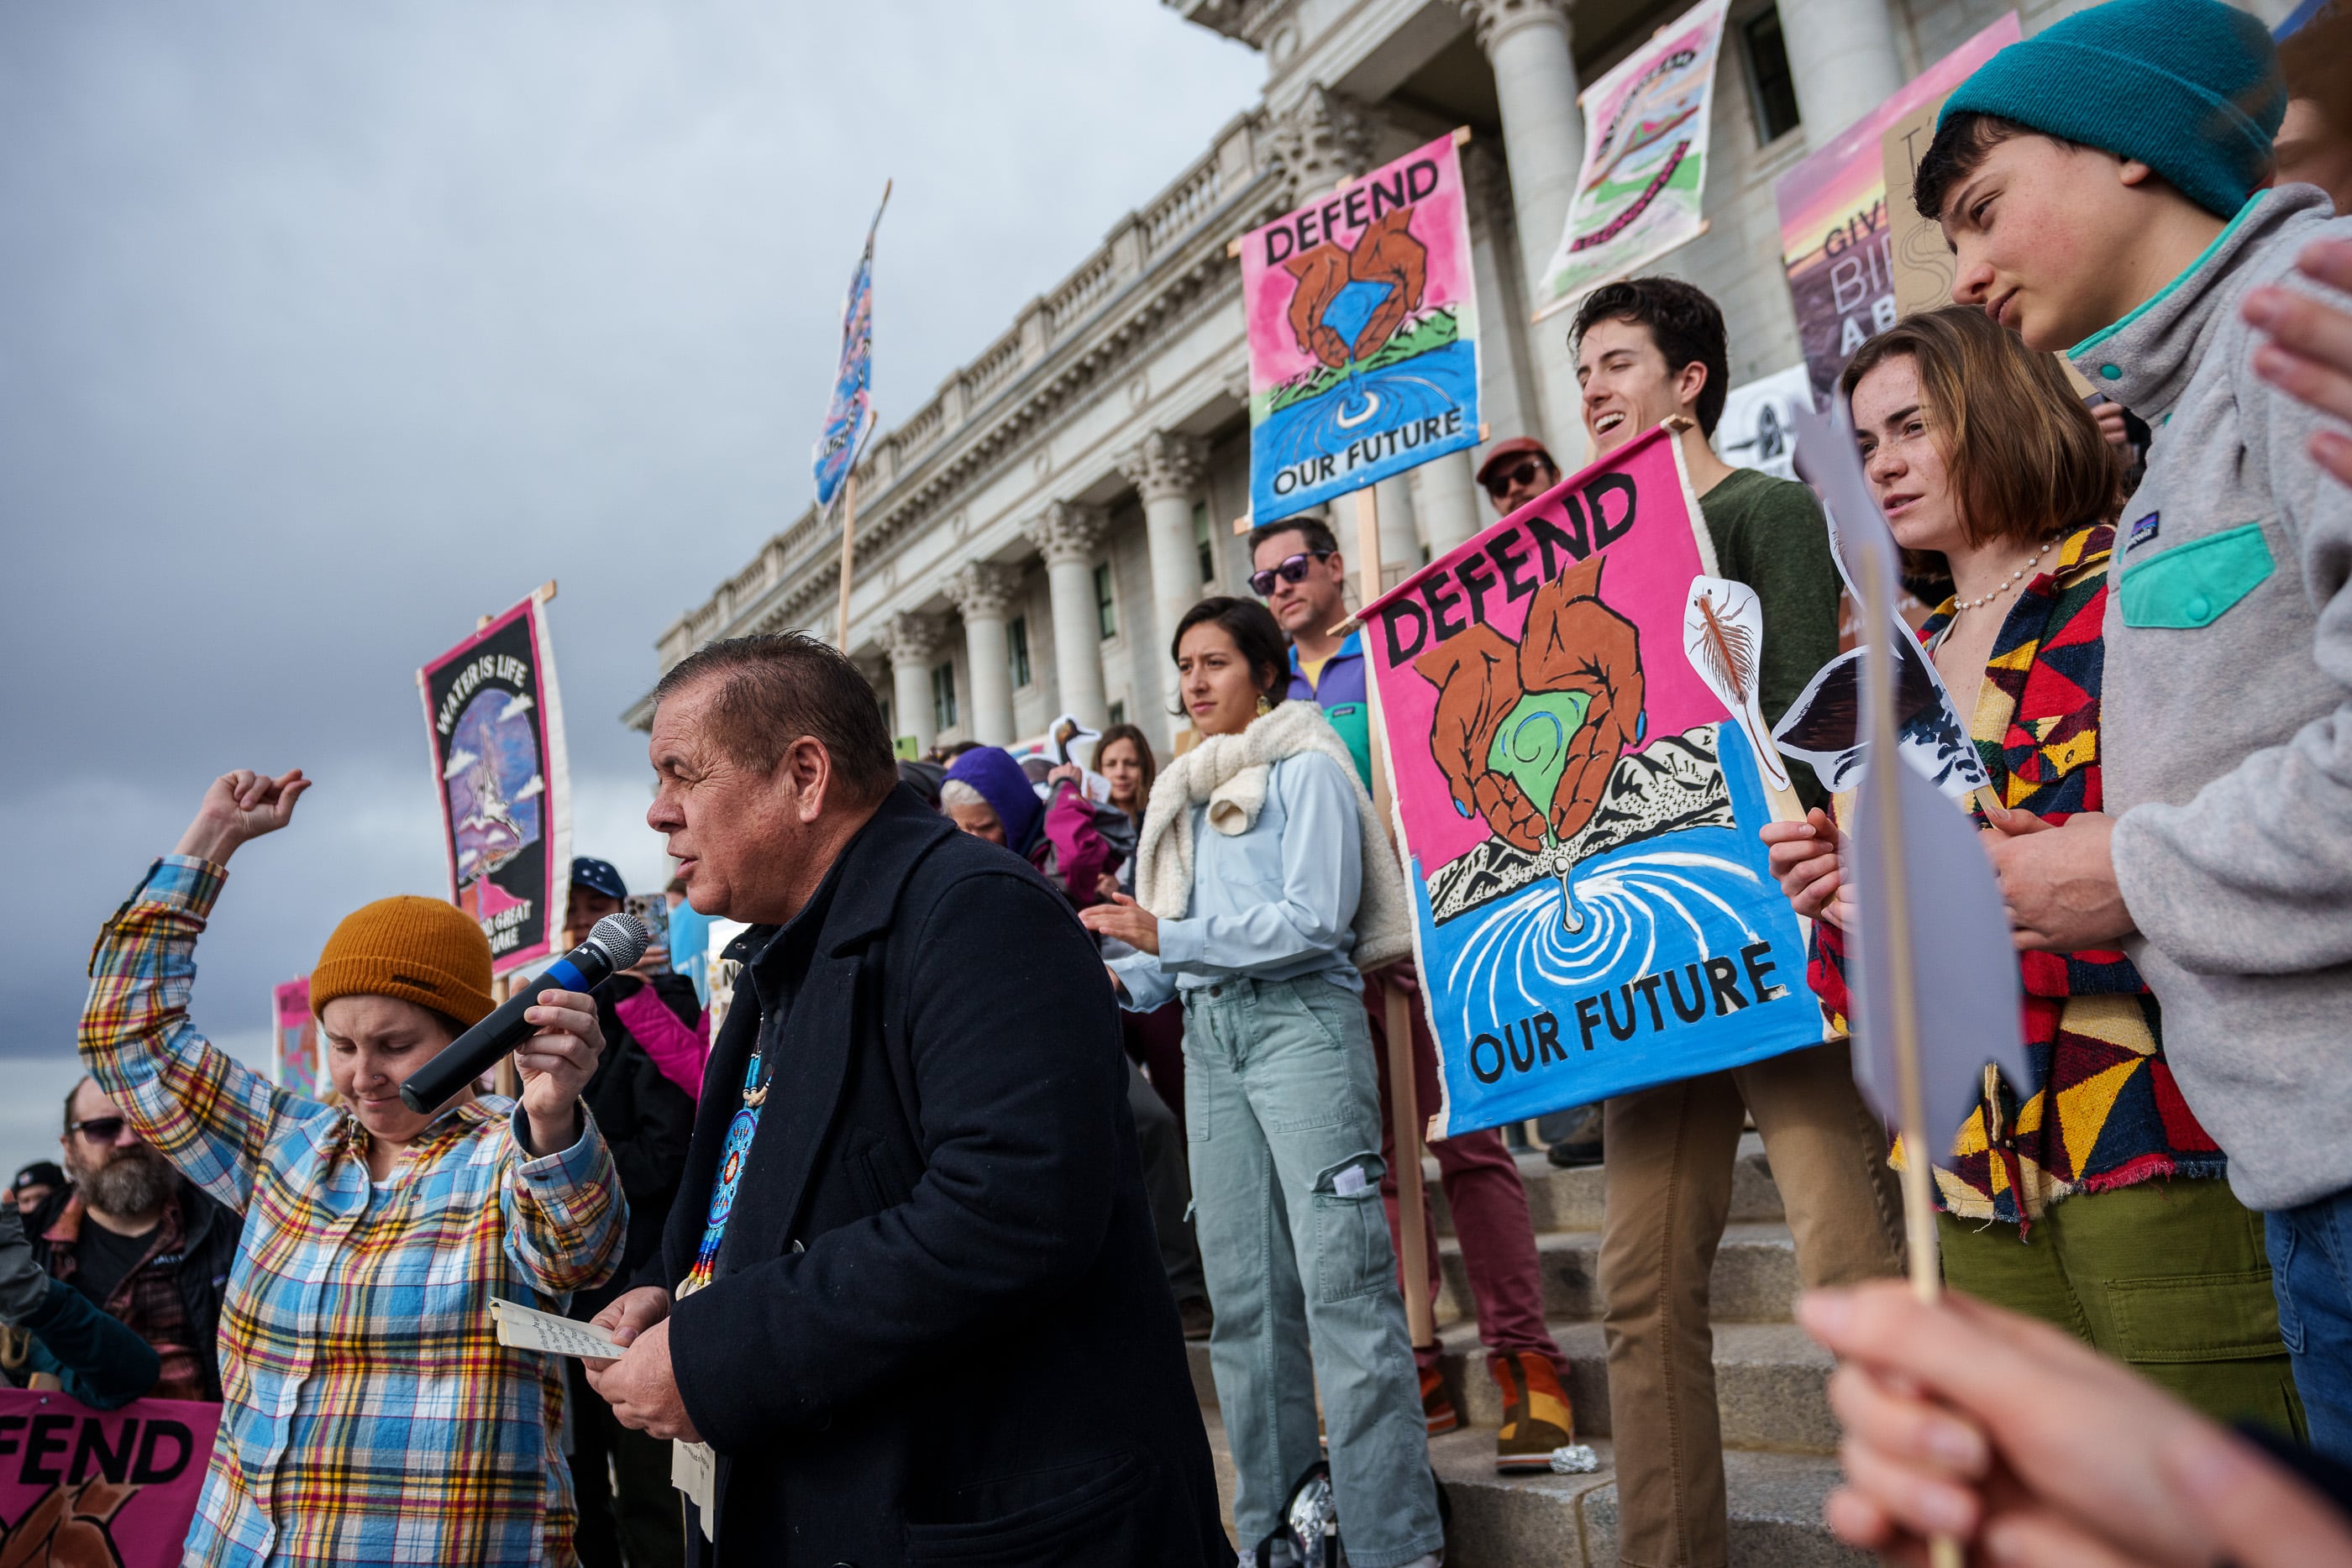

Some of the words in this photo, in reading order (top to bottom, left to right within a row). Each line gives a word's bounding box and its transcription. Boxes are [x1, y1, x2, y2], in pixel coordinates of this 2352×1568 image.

[1265, 159, 1439, 266] DEFEND
[1273, 456, 1336, 496] OUR
[1347, 407, 1462, 471] FUTURE
[1381, 472, 1637, 669] DEFEND
[436, 662, 481, 736] WATER
[479, 654, 496, 680] IS
[496, 653, 528, 689] LIFE
[491, 926, 521, 954] LAKE
[494, 899, 533, 931] GREAT
[590, 949, 606, 968] SHUR
[1470, 1010, 1568, 1084] OUR
[1574, 941, 1782, 1051] FUTURE
